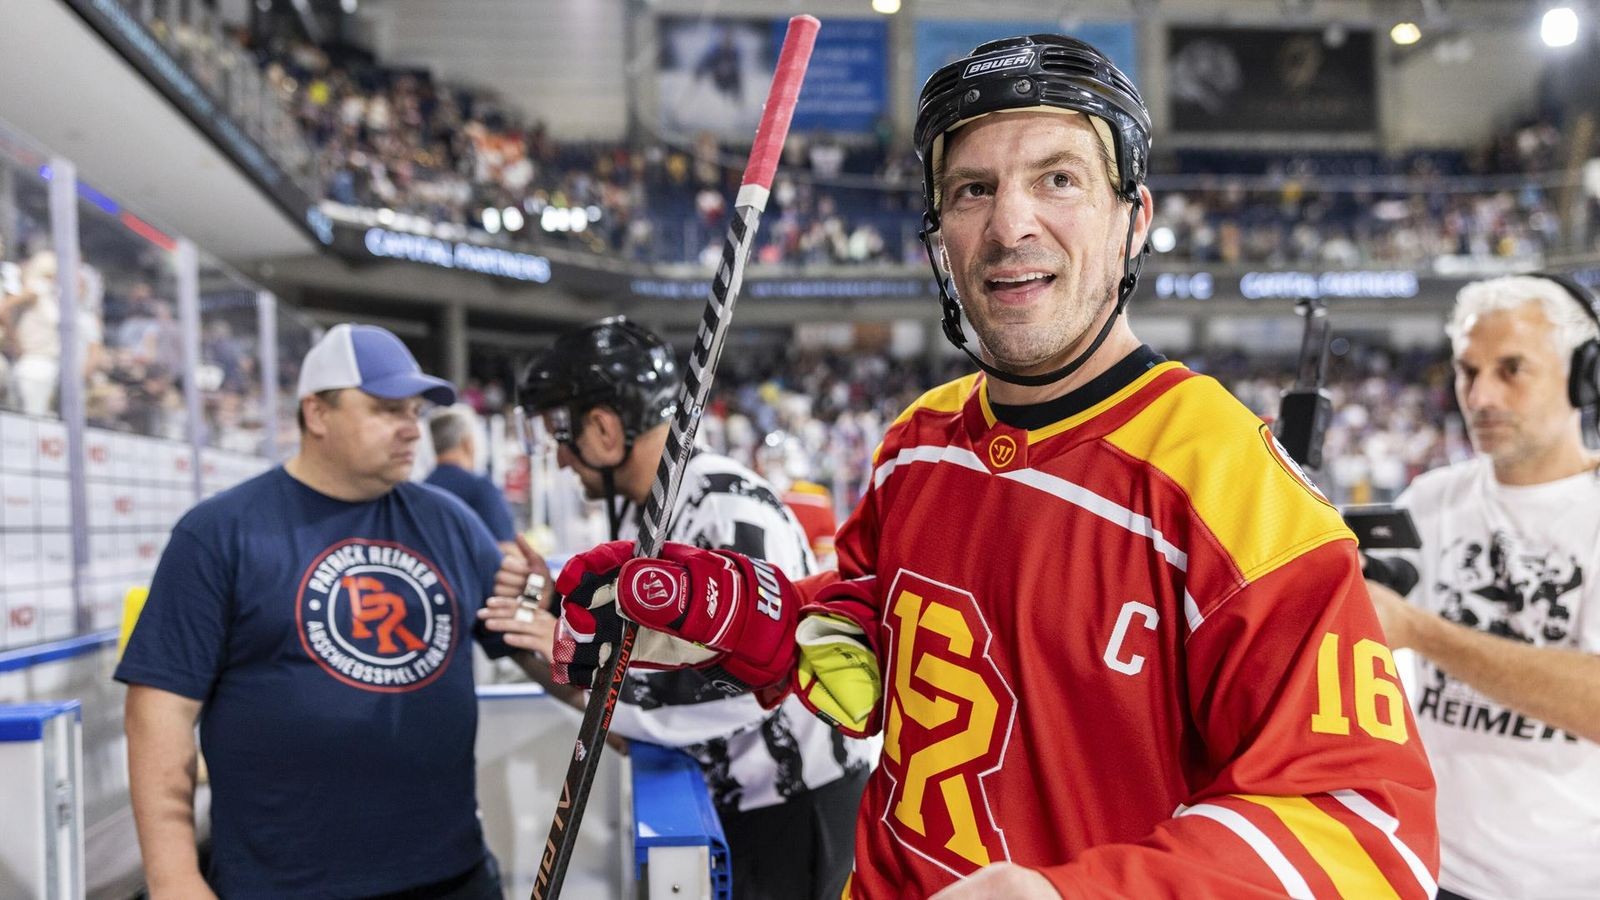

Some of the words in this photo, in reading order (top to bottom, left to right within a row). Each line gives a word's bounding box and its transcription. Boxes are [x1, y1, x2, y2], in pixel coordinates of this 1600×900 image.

[968, 56, 1027, 74] BAUER
[308, 545, 367, 594] PATRICK
[368, 546, 438, 589] REIMER
[613, 626, 635, 684] ALPHA
[1103, 600, 1160, 676] C
[1311, 631, 1409, 746] 16
